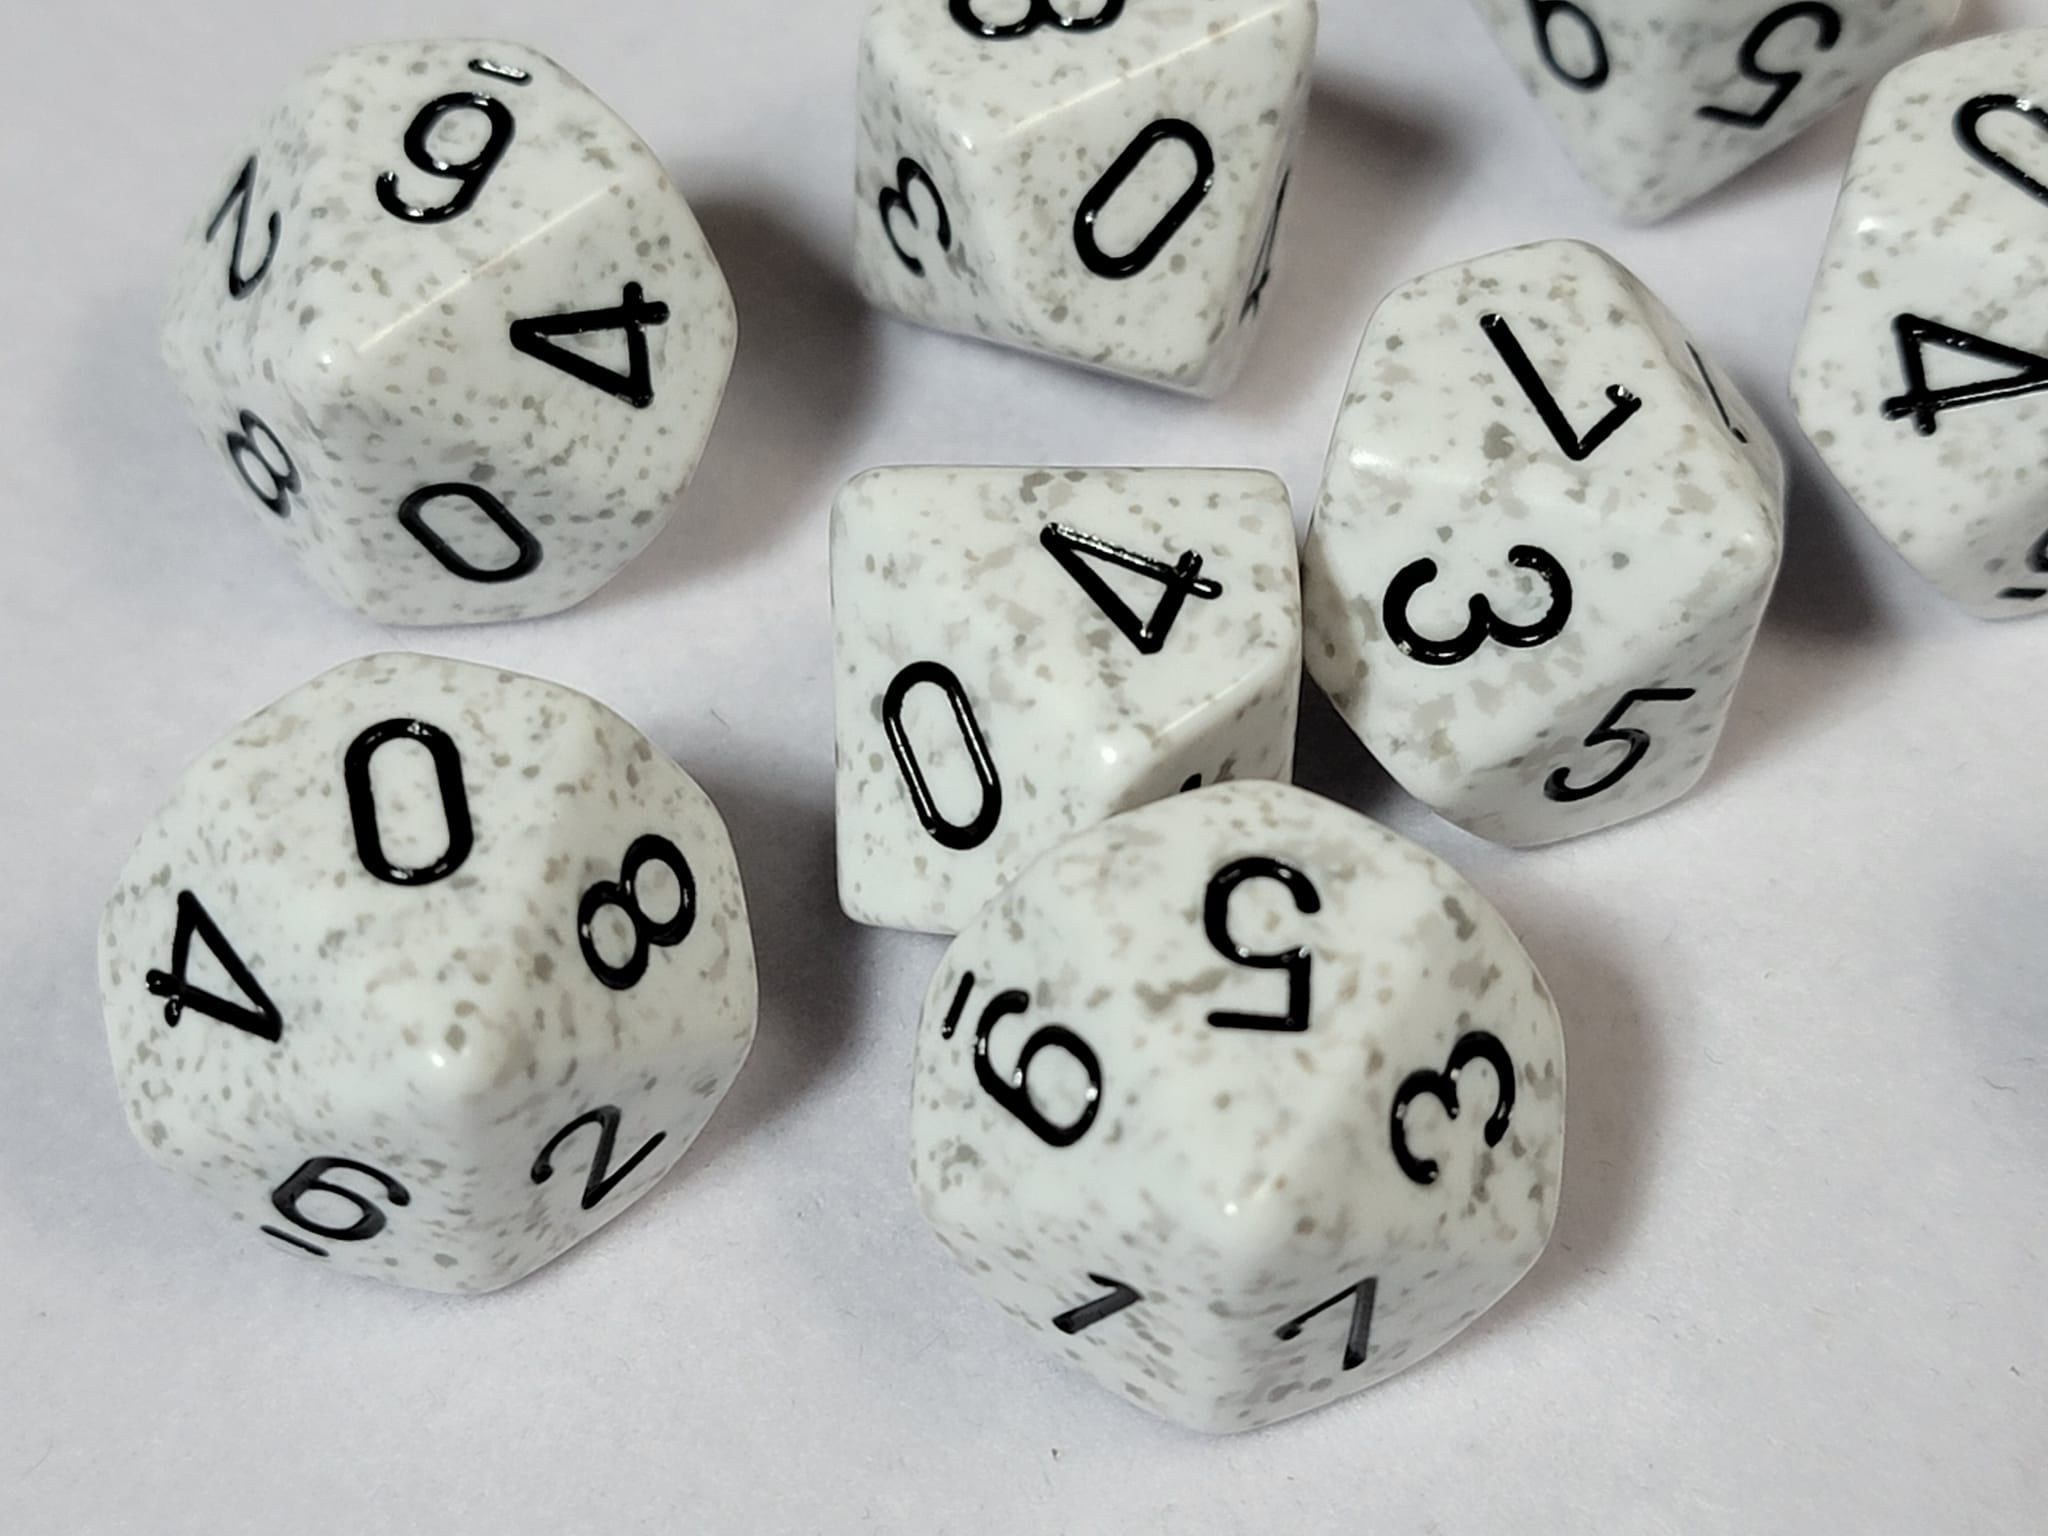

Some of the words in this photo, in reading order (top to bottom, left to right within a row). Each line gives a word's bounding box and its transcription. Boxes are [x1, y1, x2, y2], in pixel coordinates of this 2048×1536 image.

[1695, 0, 1843, 130] 5
[204, 155, 282, 300] 2
[878, 156, 952, 278] 3
[1073, 118, 1216, 280] 0
[509, 281, 671, 409] 4
[1480, 312, 1642, 461] 7
[1881, 312, 2048, 436] 4
[226, 409, 302, 518] 8
[397, 481, 544, 584] 0
[1039, 522, 1224, 655] 4
[1382, 543, 1573, 666] 3
[344, 717, 475, 887] 0
[882, 660, 1003, 851] 0
[1543, 687, 1697, 803] 5
[145, 889, 284, 1043] 4
[576, 832, 698, 991] 8
[1203, 855, 1322, 1033] 5
[530, 1104, 668, 1211] 2
[1389, 1030, 1517, 1186] 3
[1275, 1275, 1379, 1371] 7
